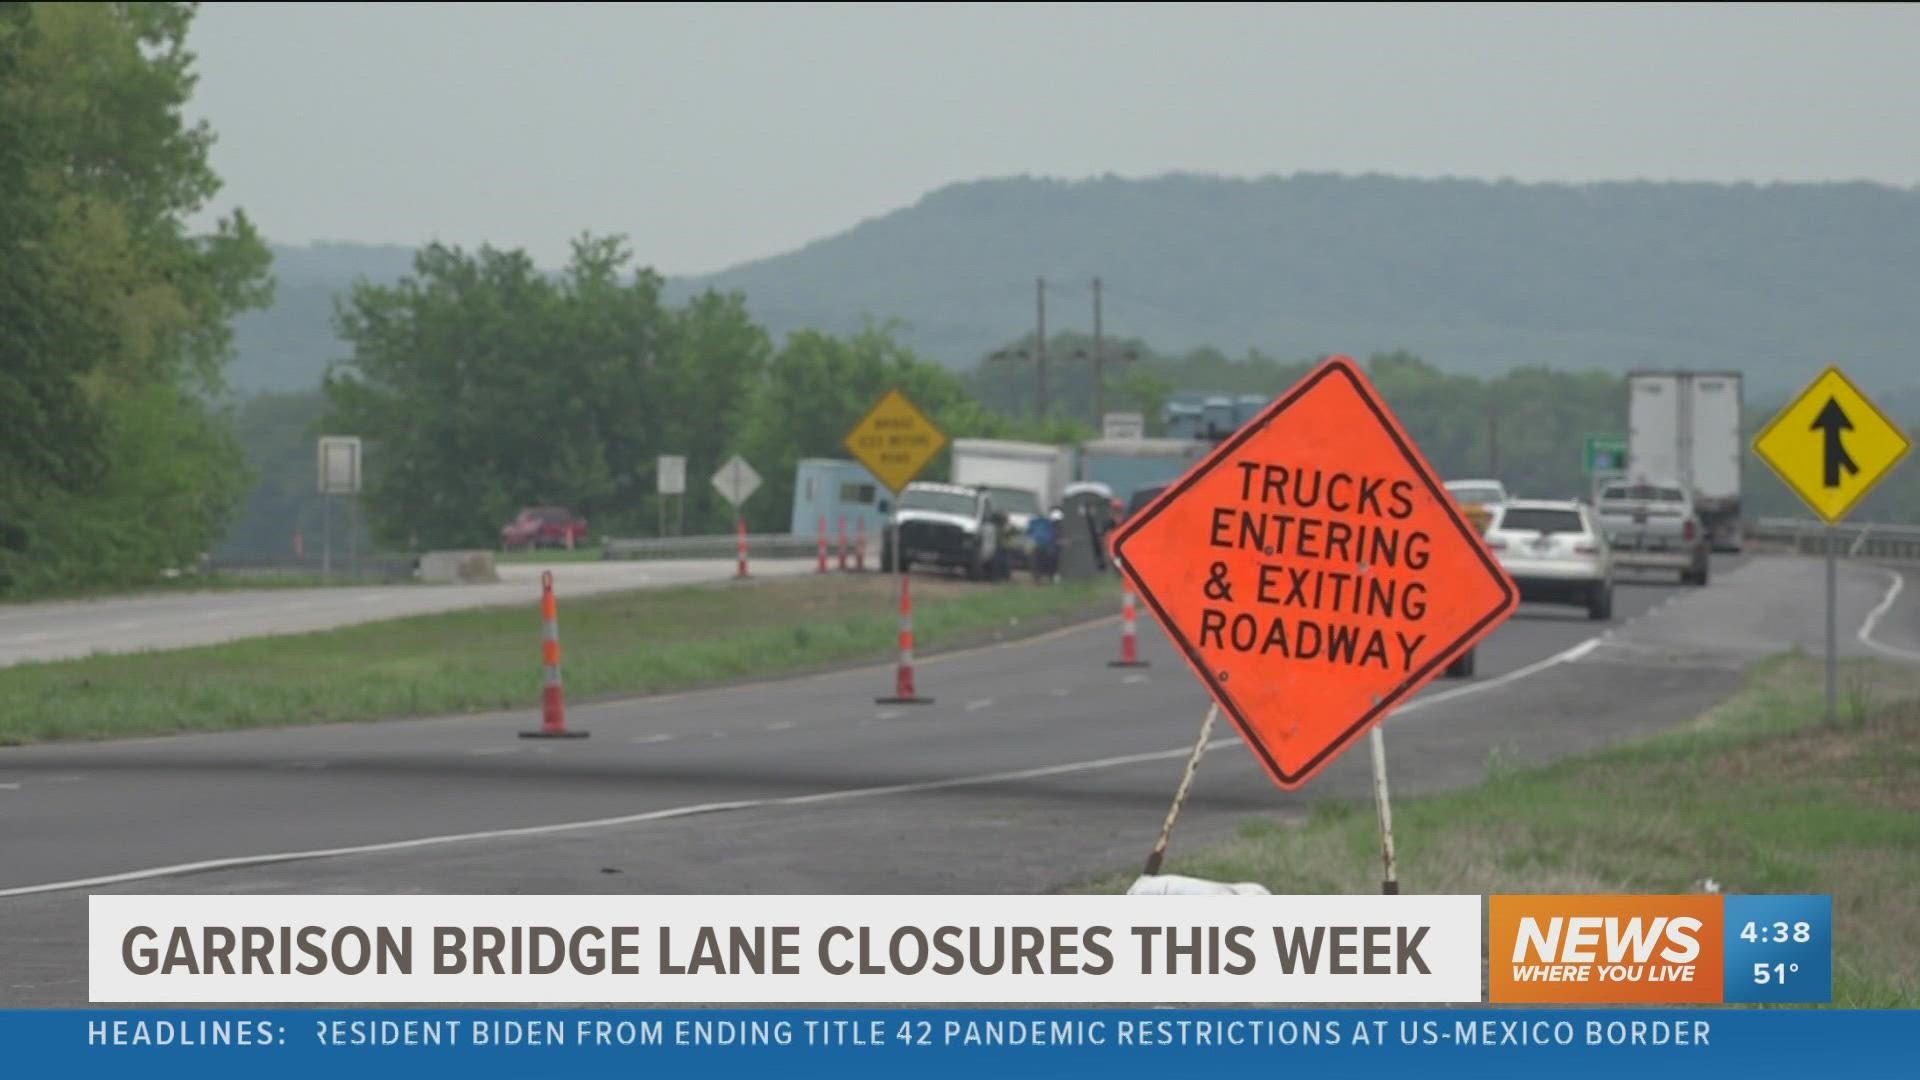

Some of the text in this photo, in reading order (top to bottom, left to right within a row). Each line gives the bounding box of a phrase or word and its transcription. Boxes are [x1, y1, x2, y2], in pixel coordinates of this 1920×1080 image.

[1237, 461, 1413, 519] TRUCKS
[1209, 507, 1431, 571] ENTERING
[1203, 561, 1427, 622] & EXITING
[1200, 609, 1425, 672] ROADWAY
